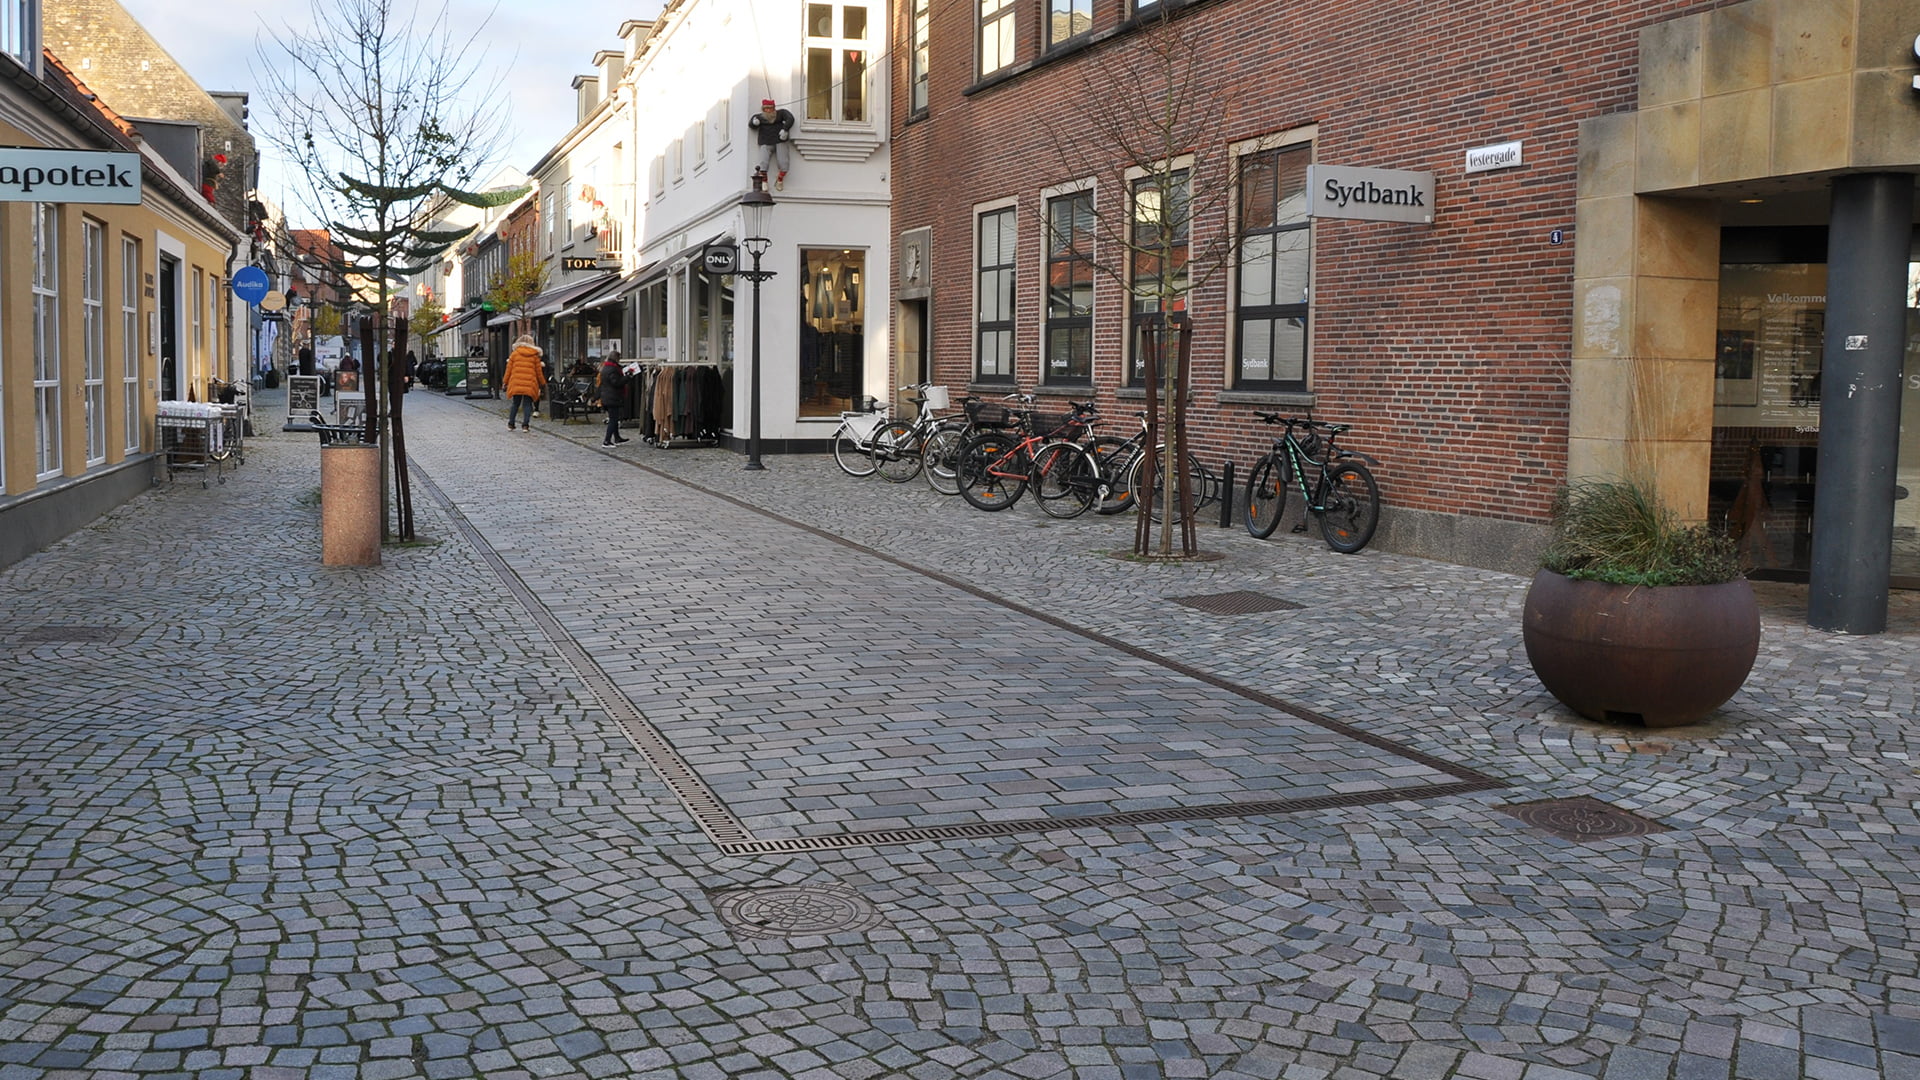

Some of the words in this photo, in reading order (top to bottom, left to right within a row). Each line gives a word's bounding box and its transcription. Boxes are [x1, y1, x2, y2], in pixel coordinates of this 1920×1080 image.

[1469, 148, 1516, 167] Vestergade
[0, 164, 133, 192] apotek
[1325, 178, 1425, 207] Sydbank
[706, 255, 734, 264] ONLY
[1242, 359, 1269, 370] Sydbank
